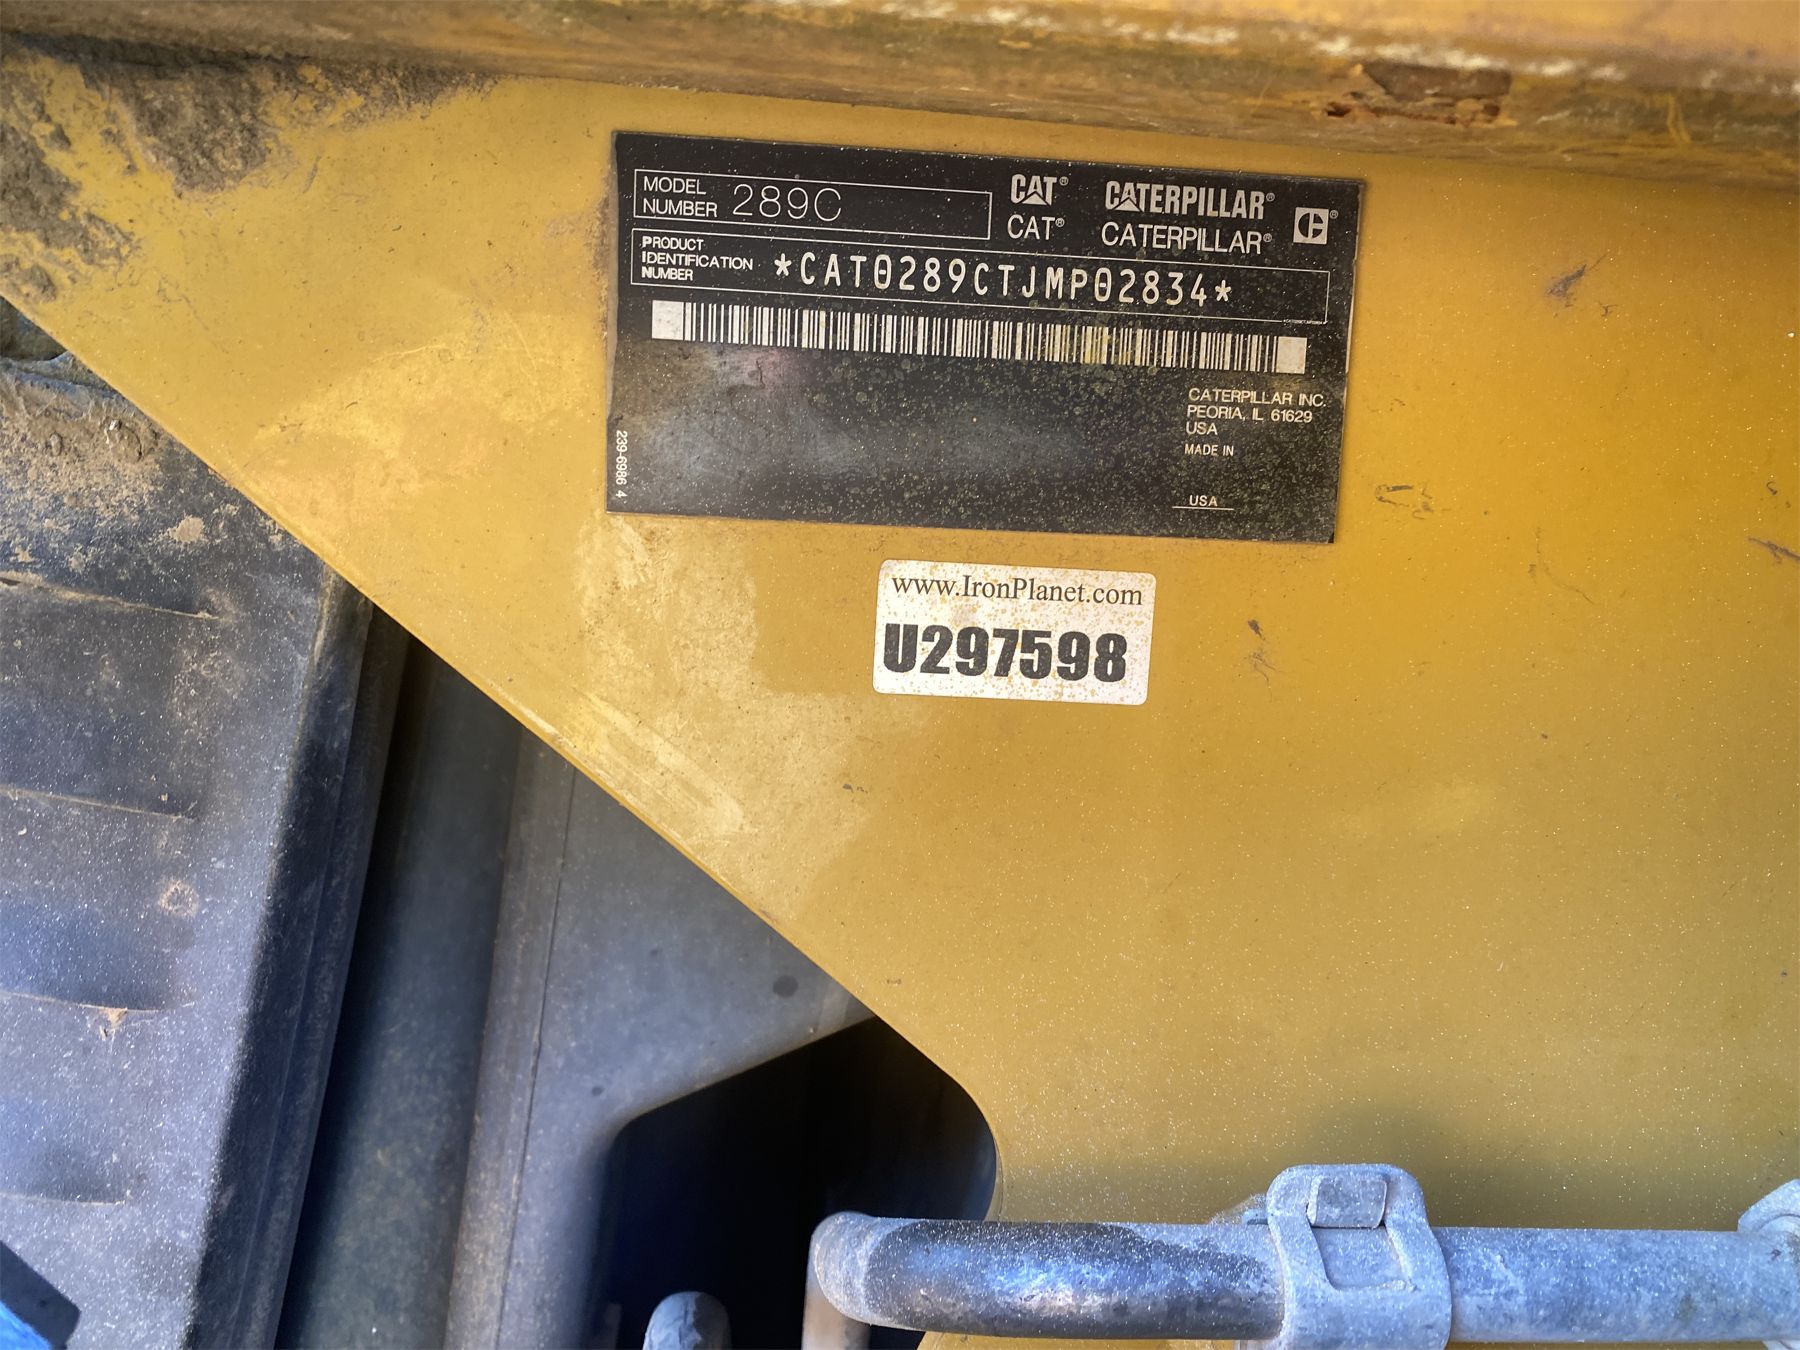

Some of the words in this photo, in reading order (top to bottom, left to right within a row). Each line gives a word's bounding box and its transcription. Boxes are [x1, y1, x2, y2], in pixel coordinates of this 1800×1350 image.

[643, 175, 707, 195] MODEL
[642, 199, 718, 218] NUMBER
[733, 183, 841, 222] 289C
[641, 235, 704, 251] PRODUCT
[641, 251, 753, 271] IDENTIFICATION
[641, 266, 694, 282] NUMBER
[1188, 387, 1293, 405] CATERPILLAR
[1298, 393, 1327, 408] INC.
[1186, 404, 1246, 421] PEORIA,
[1252, 407, 1264, 421] IL
[1270, 409, 1313, 423] 61629
[1185, 422, 1218, 436] USA
[615, 430, 628, 485] 239-6986
[1184, 443, 1218, 457] MADE
[1222, 445, 1234, 457] IN
[1189, 494, 1218, 507] USA
[892, 574, 1143, 606] www.IronPlanet.com
[883, 622, 1128, 683] U297598
